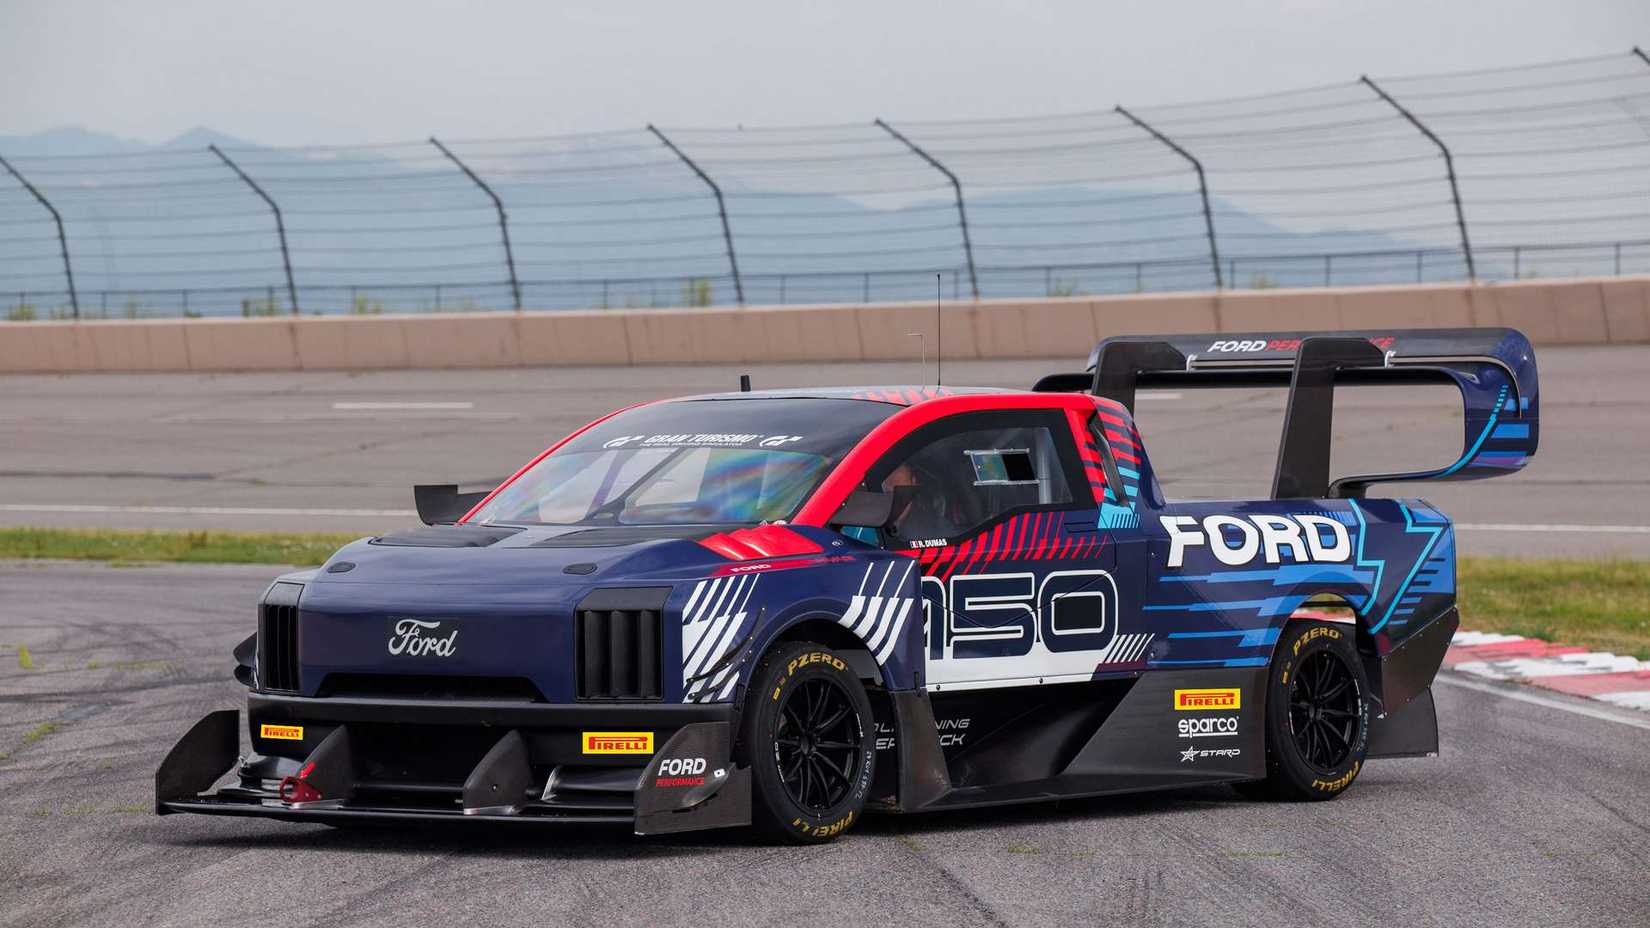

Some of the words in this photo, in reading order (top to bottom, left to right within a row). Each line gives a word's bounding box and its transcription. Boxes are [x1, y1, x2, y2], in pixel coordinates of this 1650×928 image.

[1207, 340, 1267, 352] FORD
[644, 434, 693, 443] GRAN
[688, 434, 758, 443] TURISMO
[925, 538, 947, 547] DUMAS
[1160, 515, 1351, 567] FORD
[731, 563, 772, 573] FORD
[388, 619, 458, 656] Ford
[1180, 692, 1235, 706] PIRELLI
[264, 727, 300, 737] PIRELLI
[1178, 717, 1238, 738] sparco
[588, 736, 648, 750] PIRELLI
[1200, 749, 1240, 758] STARD
[658, 758, 707, 776] FORD
